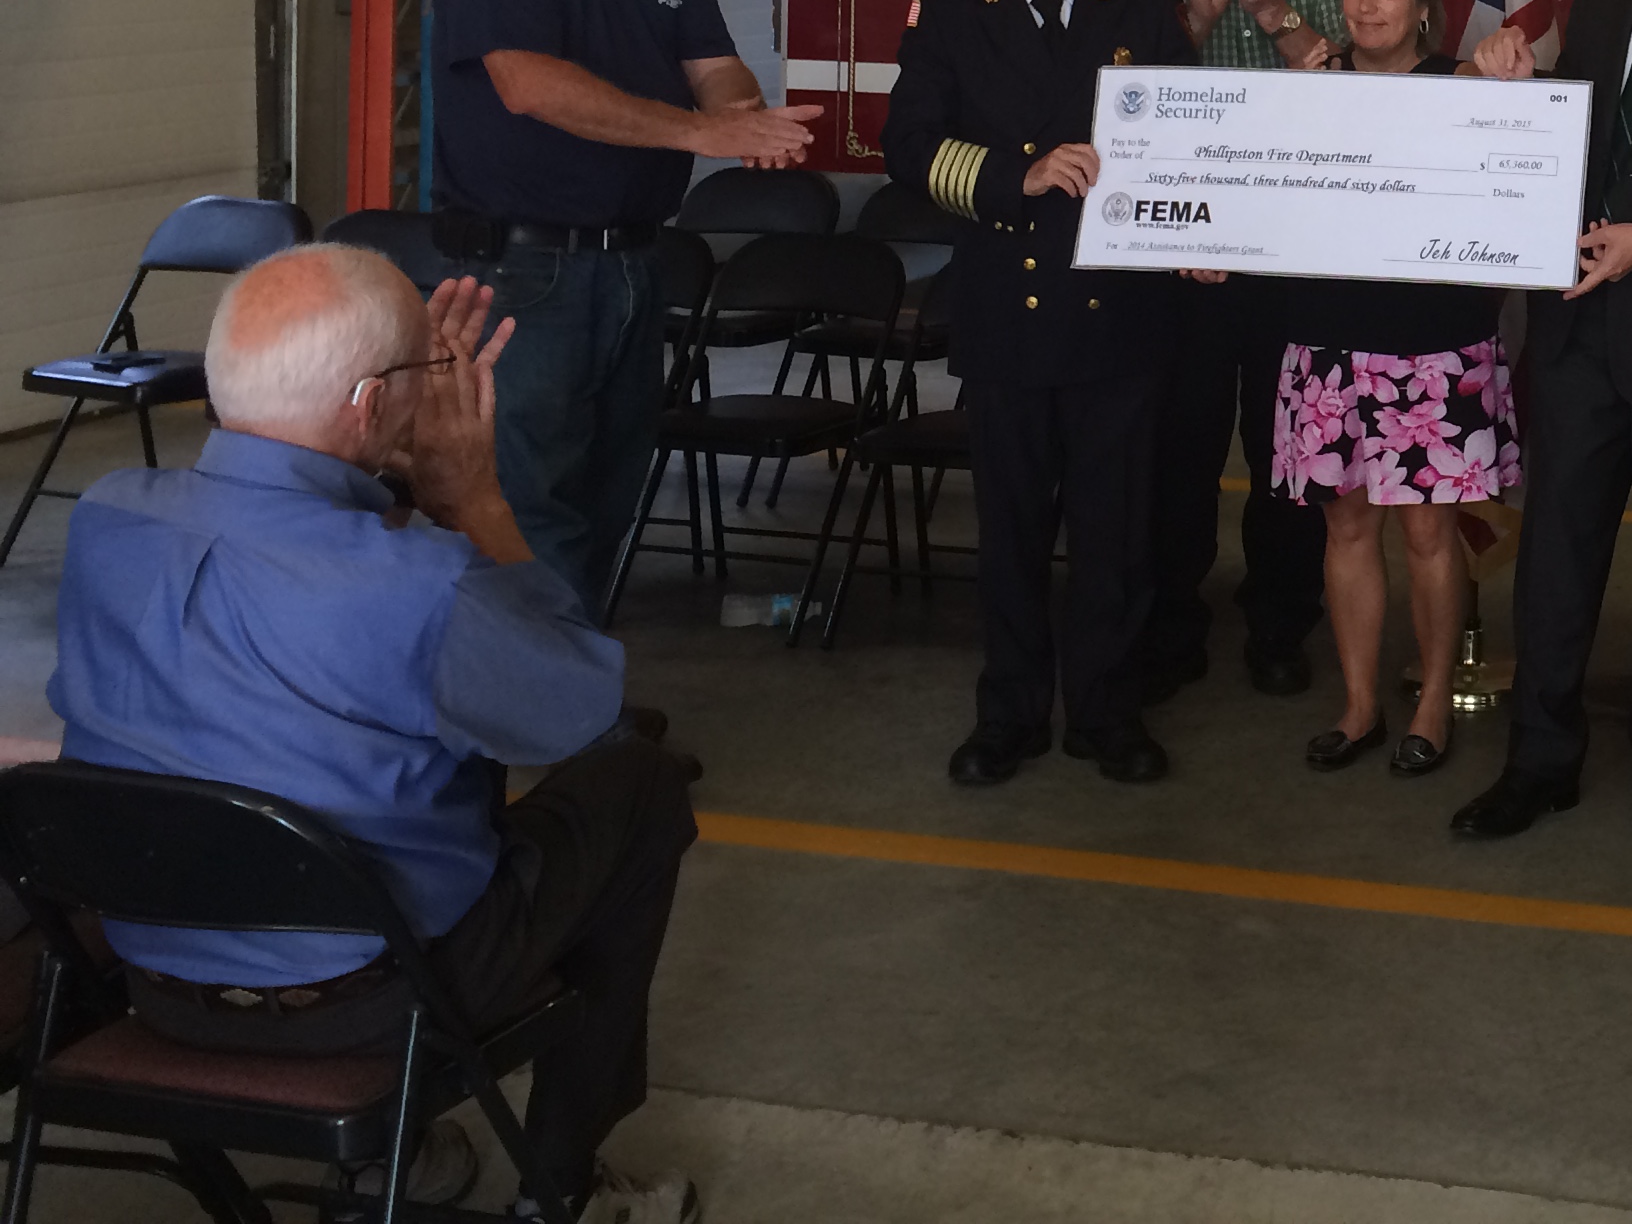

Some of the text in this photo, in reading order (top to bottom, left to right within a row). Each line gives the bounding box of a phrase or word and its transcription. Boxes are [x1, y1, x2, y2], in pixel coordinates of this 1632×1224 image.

[1157, 87, 1247, 104] Homeland
[1549, 94, 1568, 103] 001
[1155, 104, 1226, 124] Security
[1468, 117, 1496, 128] August
[1512, 119, 1532, 128] 2015
[1111, 138, 1151, 148] Pay to the
[1110, 150, 1145, 160] Order of
[1194, 145, 1372, 166] Phillipston Fire Department
[1479, 160, 1543, 171] $ 65,360.00
[1146, 171, 1416, 193] Sixty-five thousand, three hundred and sixty dollars
[1492, 188, 1525, 199] Dollars
[1134, 200, 1212, 223] FEMA
[1419, 238, 1520, 265] Jeh Johnson
